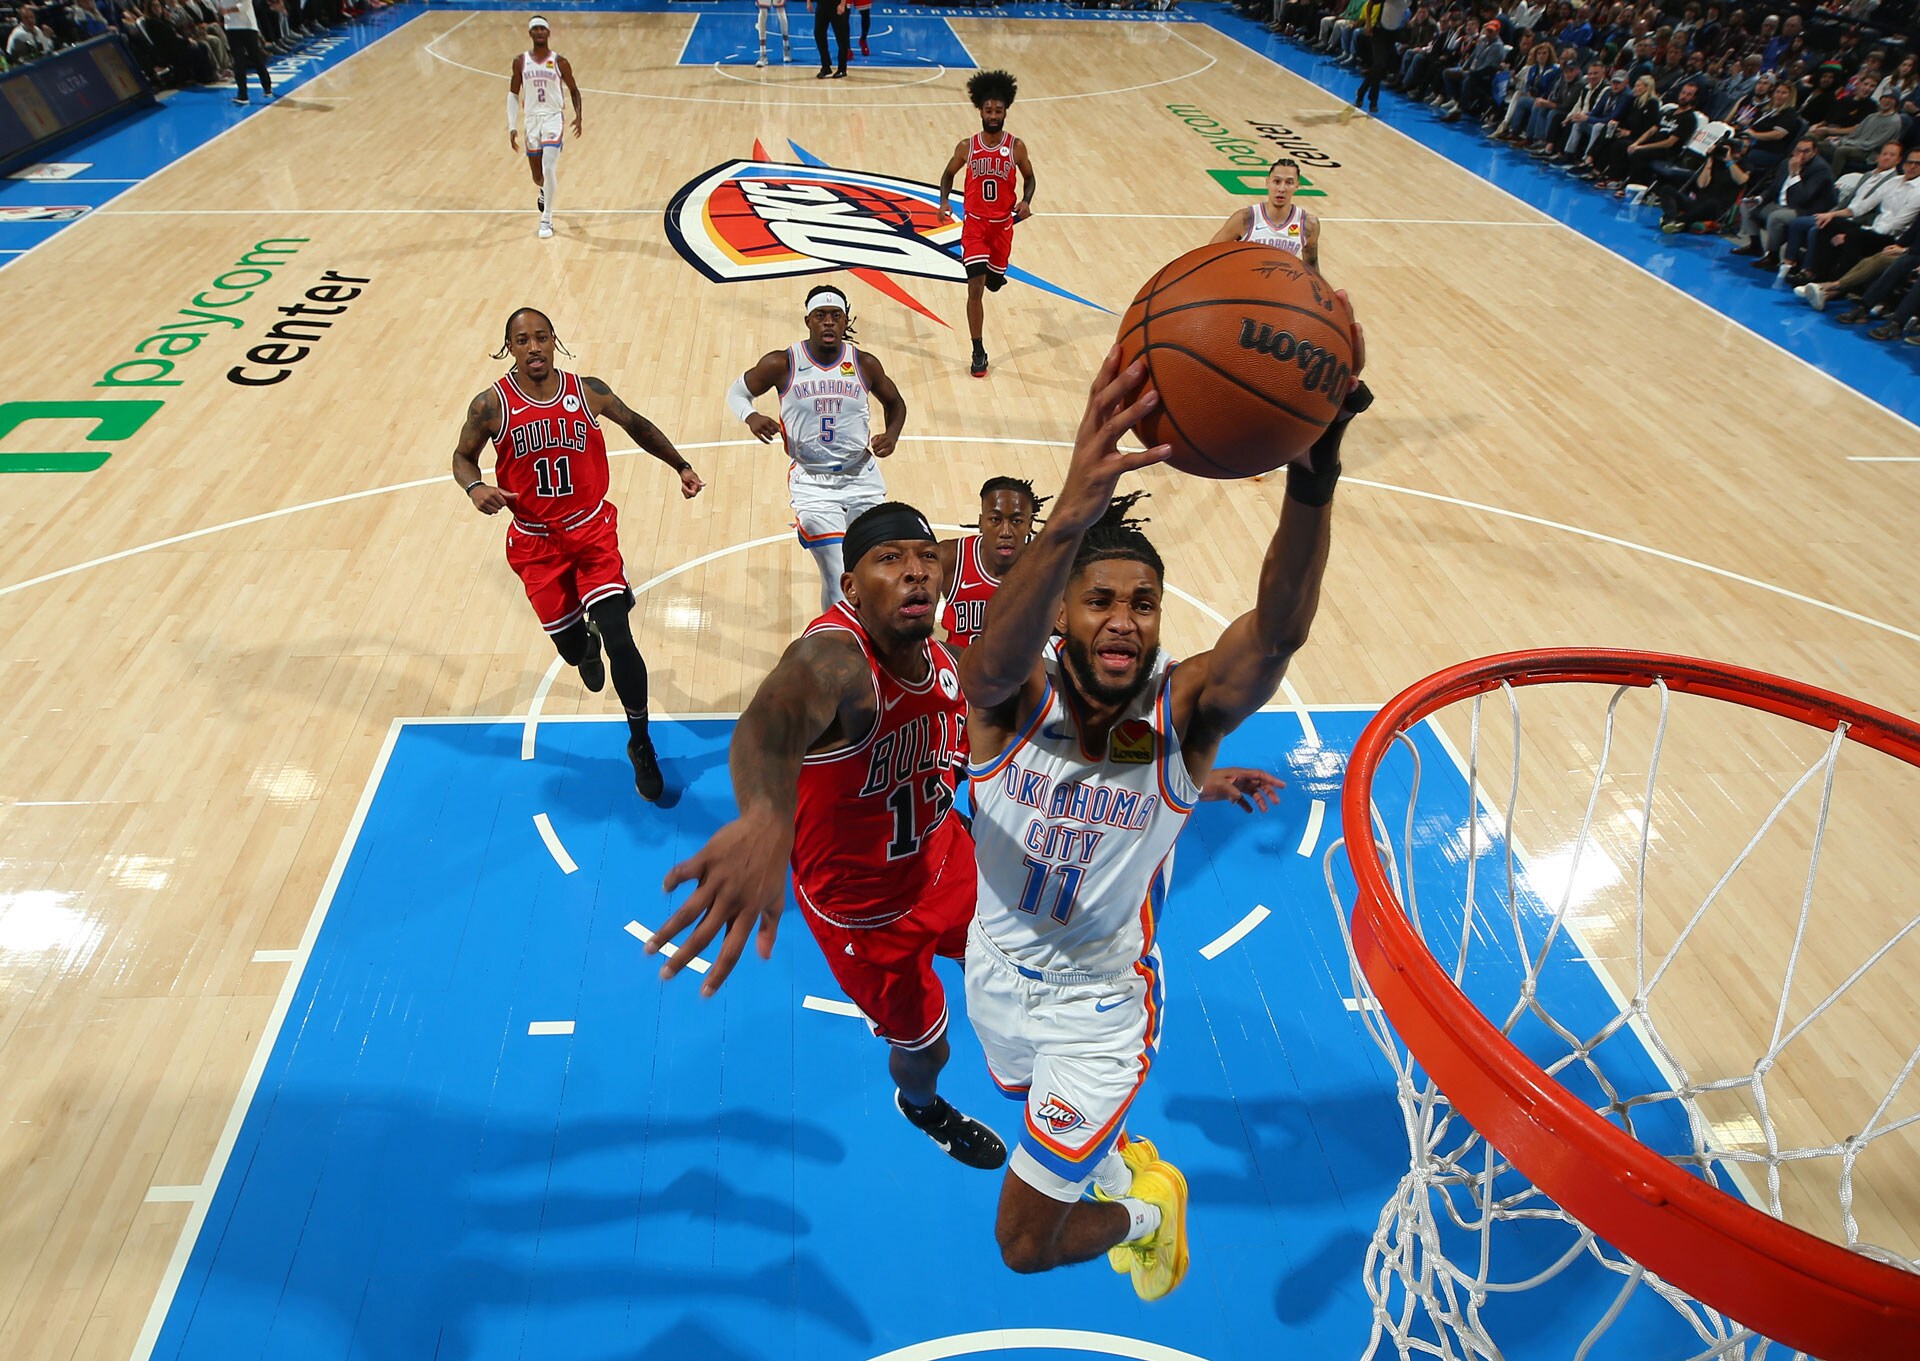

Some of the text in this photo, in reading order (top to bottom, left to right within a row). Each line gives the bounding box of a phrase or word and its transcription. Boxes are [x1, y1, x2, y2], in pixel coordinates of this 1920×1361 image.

[882, 8, 1008, 17] OKLAHOMA
[1024, 10, 1076, 18] CITY
[266, 36, 350, 73] paycom
[534, 79, 547, 87] CITY
[537, 88, 546, 102] 2
[1166, 104, 1273, 166] paycom
[1245, 120, 1342, 168] center
[971, 157, 1012, 180] BULLS
[982, 179, 998, 202] 0
[92, 238, 311, 387] paycom
[226, 270, 371, 386] center
[792, 379, 861, 400] OKLAHOMA
[813, 397, 844, 414] CITY
[510, 418, 587, 459] BULLS
[819, 415, 836, 444] 5
[533, 456, 574, 497] 11
[953, 600, 986, 633] BU
[1004, 760, 1158, 830] OKLAHOMA
[1024, 818, 1104, 863] CITY
[1018, 854, 1087, 926] 11
[1038, 1103, 1075, 1122] OKC
